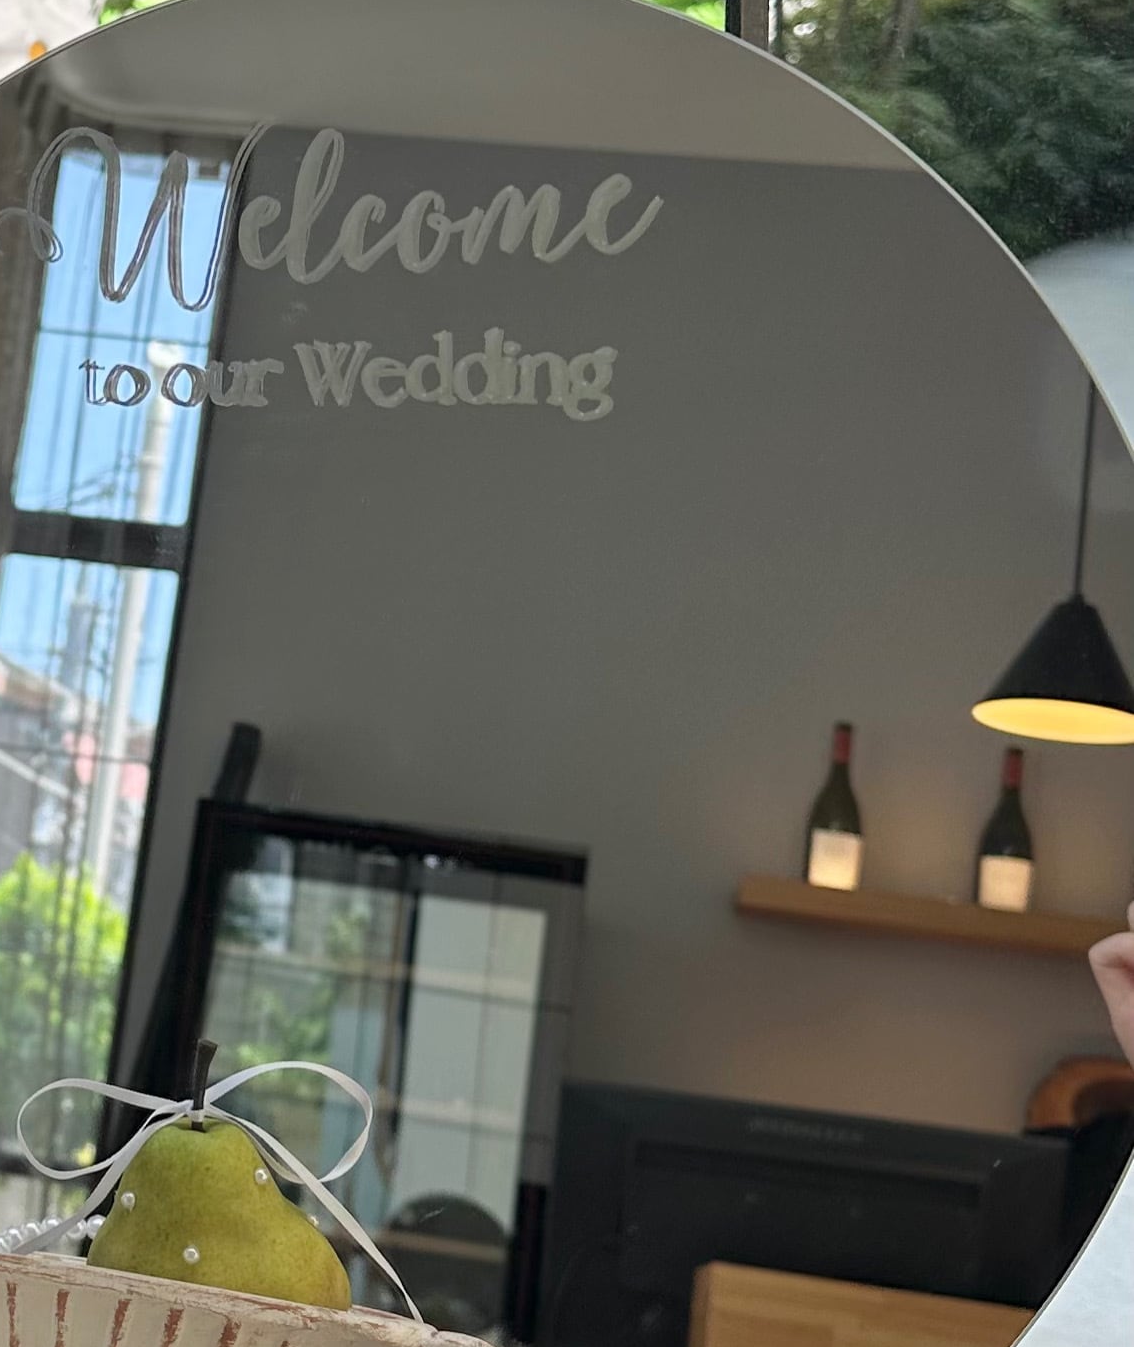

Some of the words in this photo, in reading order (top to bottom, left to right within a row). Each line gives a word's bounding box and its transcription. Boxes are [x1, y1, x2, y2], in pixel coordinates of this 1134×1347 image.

[78, 357, 151, 407] to
[162, 357, 284, 407] our
[293, 326, 619, 421] Wedding
